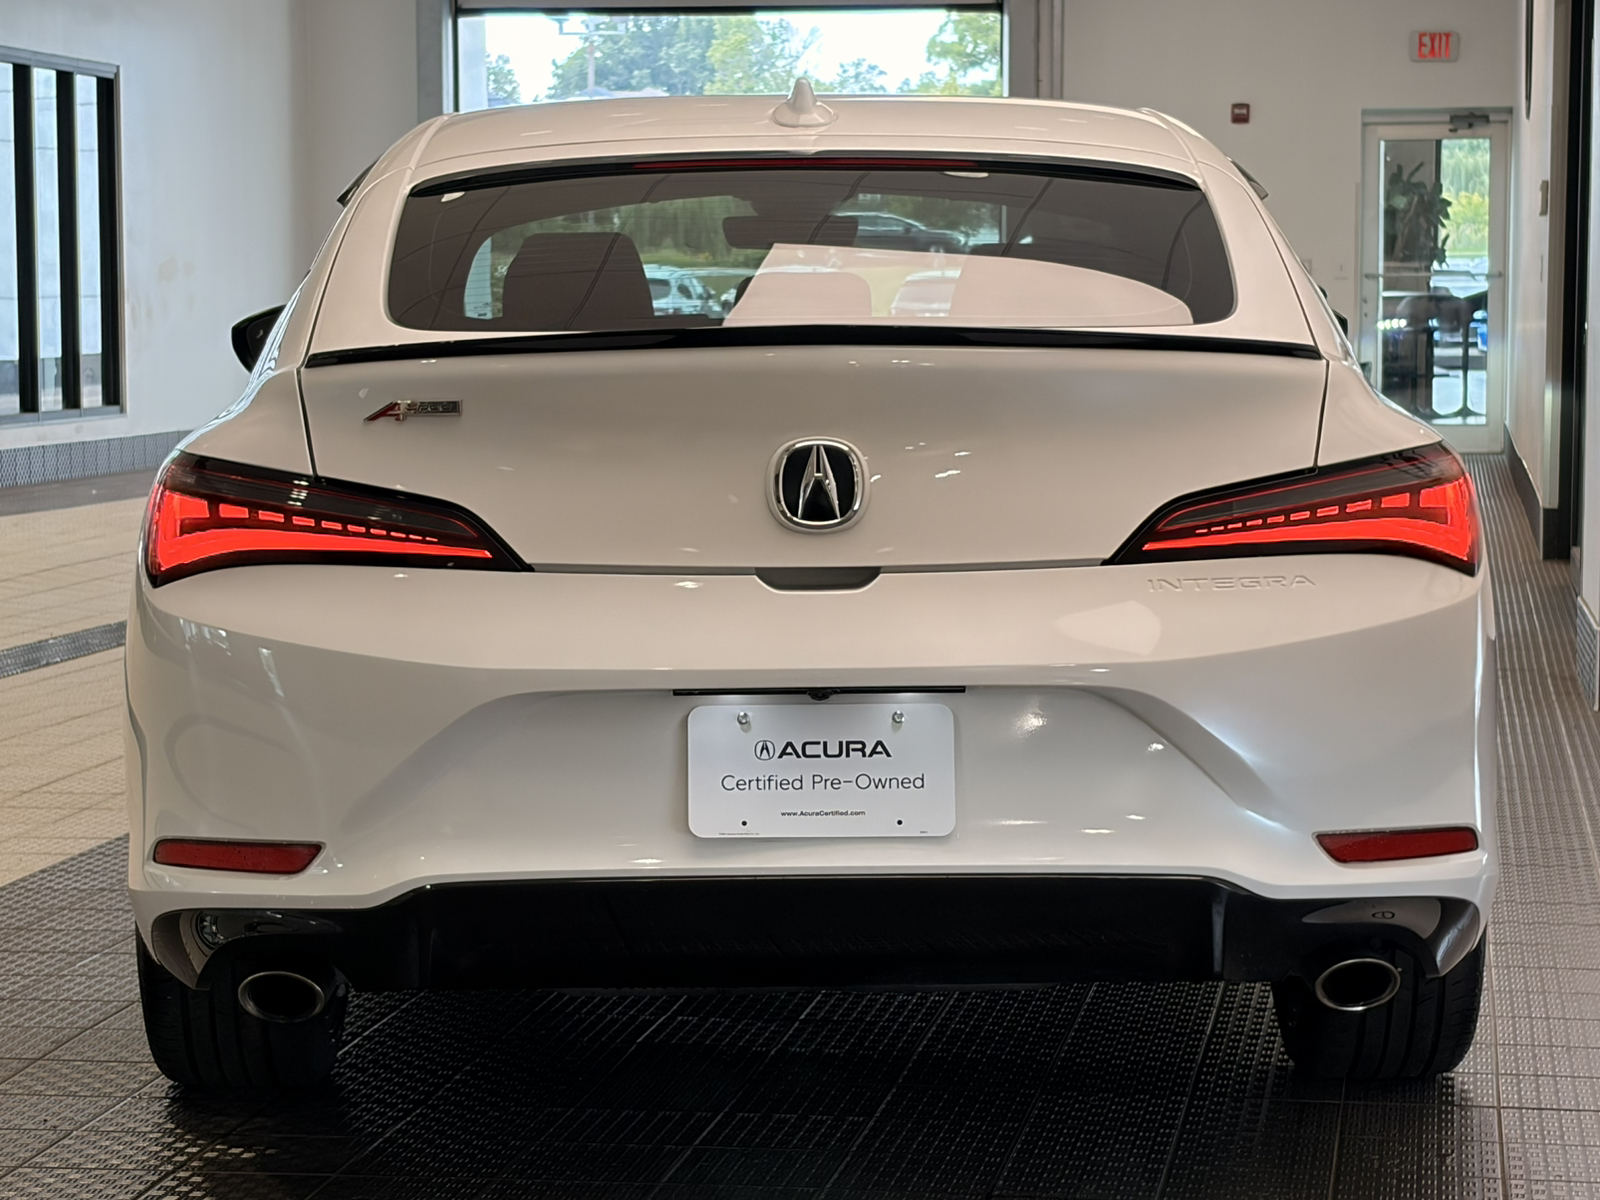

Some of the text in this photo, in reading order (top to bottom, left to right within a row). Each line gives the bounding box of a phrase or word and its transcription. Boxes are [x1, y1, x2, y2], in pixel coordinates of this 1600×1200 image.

[1418, 32, 1452, 59] EXIT
[1147, 575, 1316, 592] INTEGRA
[777, 740, 892, 759] ACURA
[721, 773, 925, 791] Certified Pre-Owned
[780, 809, 866, 817] www.AcuraCertified.com
